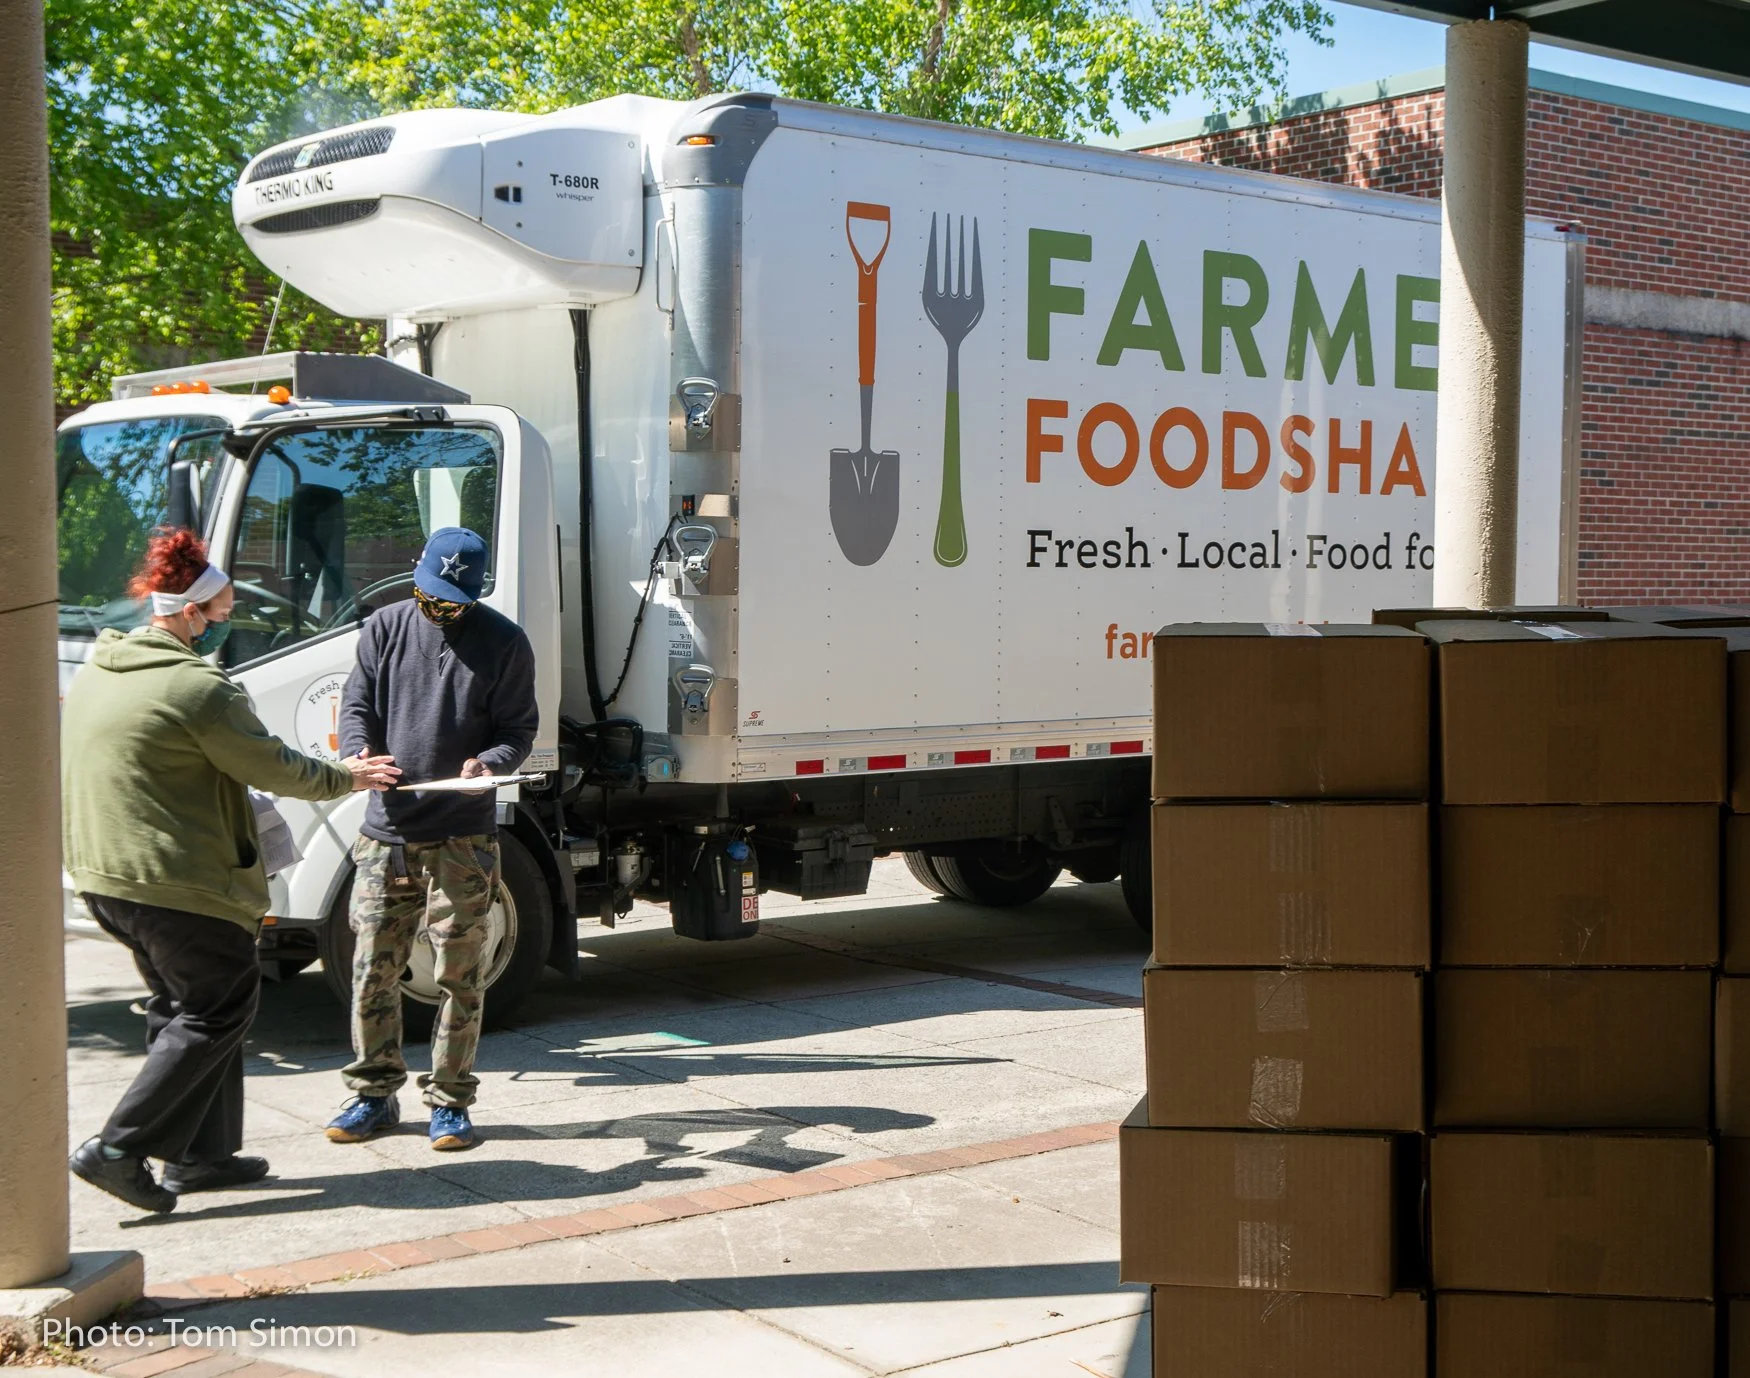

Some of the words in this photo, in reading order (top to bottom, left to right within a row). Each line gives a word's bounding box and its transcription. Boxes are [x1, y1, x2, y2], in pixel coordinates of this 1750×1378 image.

[255, 178, 300, 206] THERMO
[304, 171, 333, 196] KING
[550, 173, 599, 190] T-680R
[556, 192, 595, 202] whisper
[1027, 228, 1441, 391] FARME
[1026, 398, 1426, 497] FOODSHA
[1026, 527, 1151, 569] Fresh
[1177, 529, 1281, 570] Local
[1305, 531, 1392, 570] Food
[308, 680, 340, 705] Fresh
[309, 742, 337, 762] Foo
[743, 910, 758, 920] ON
